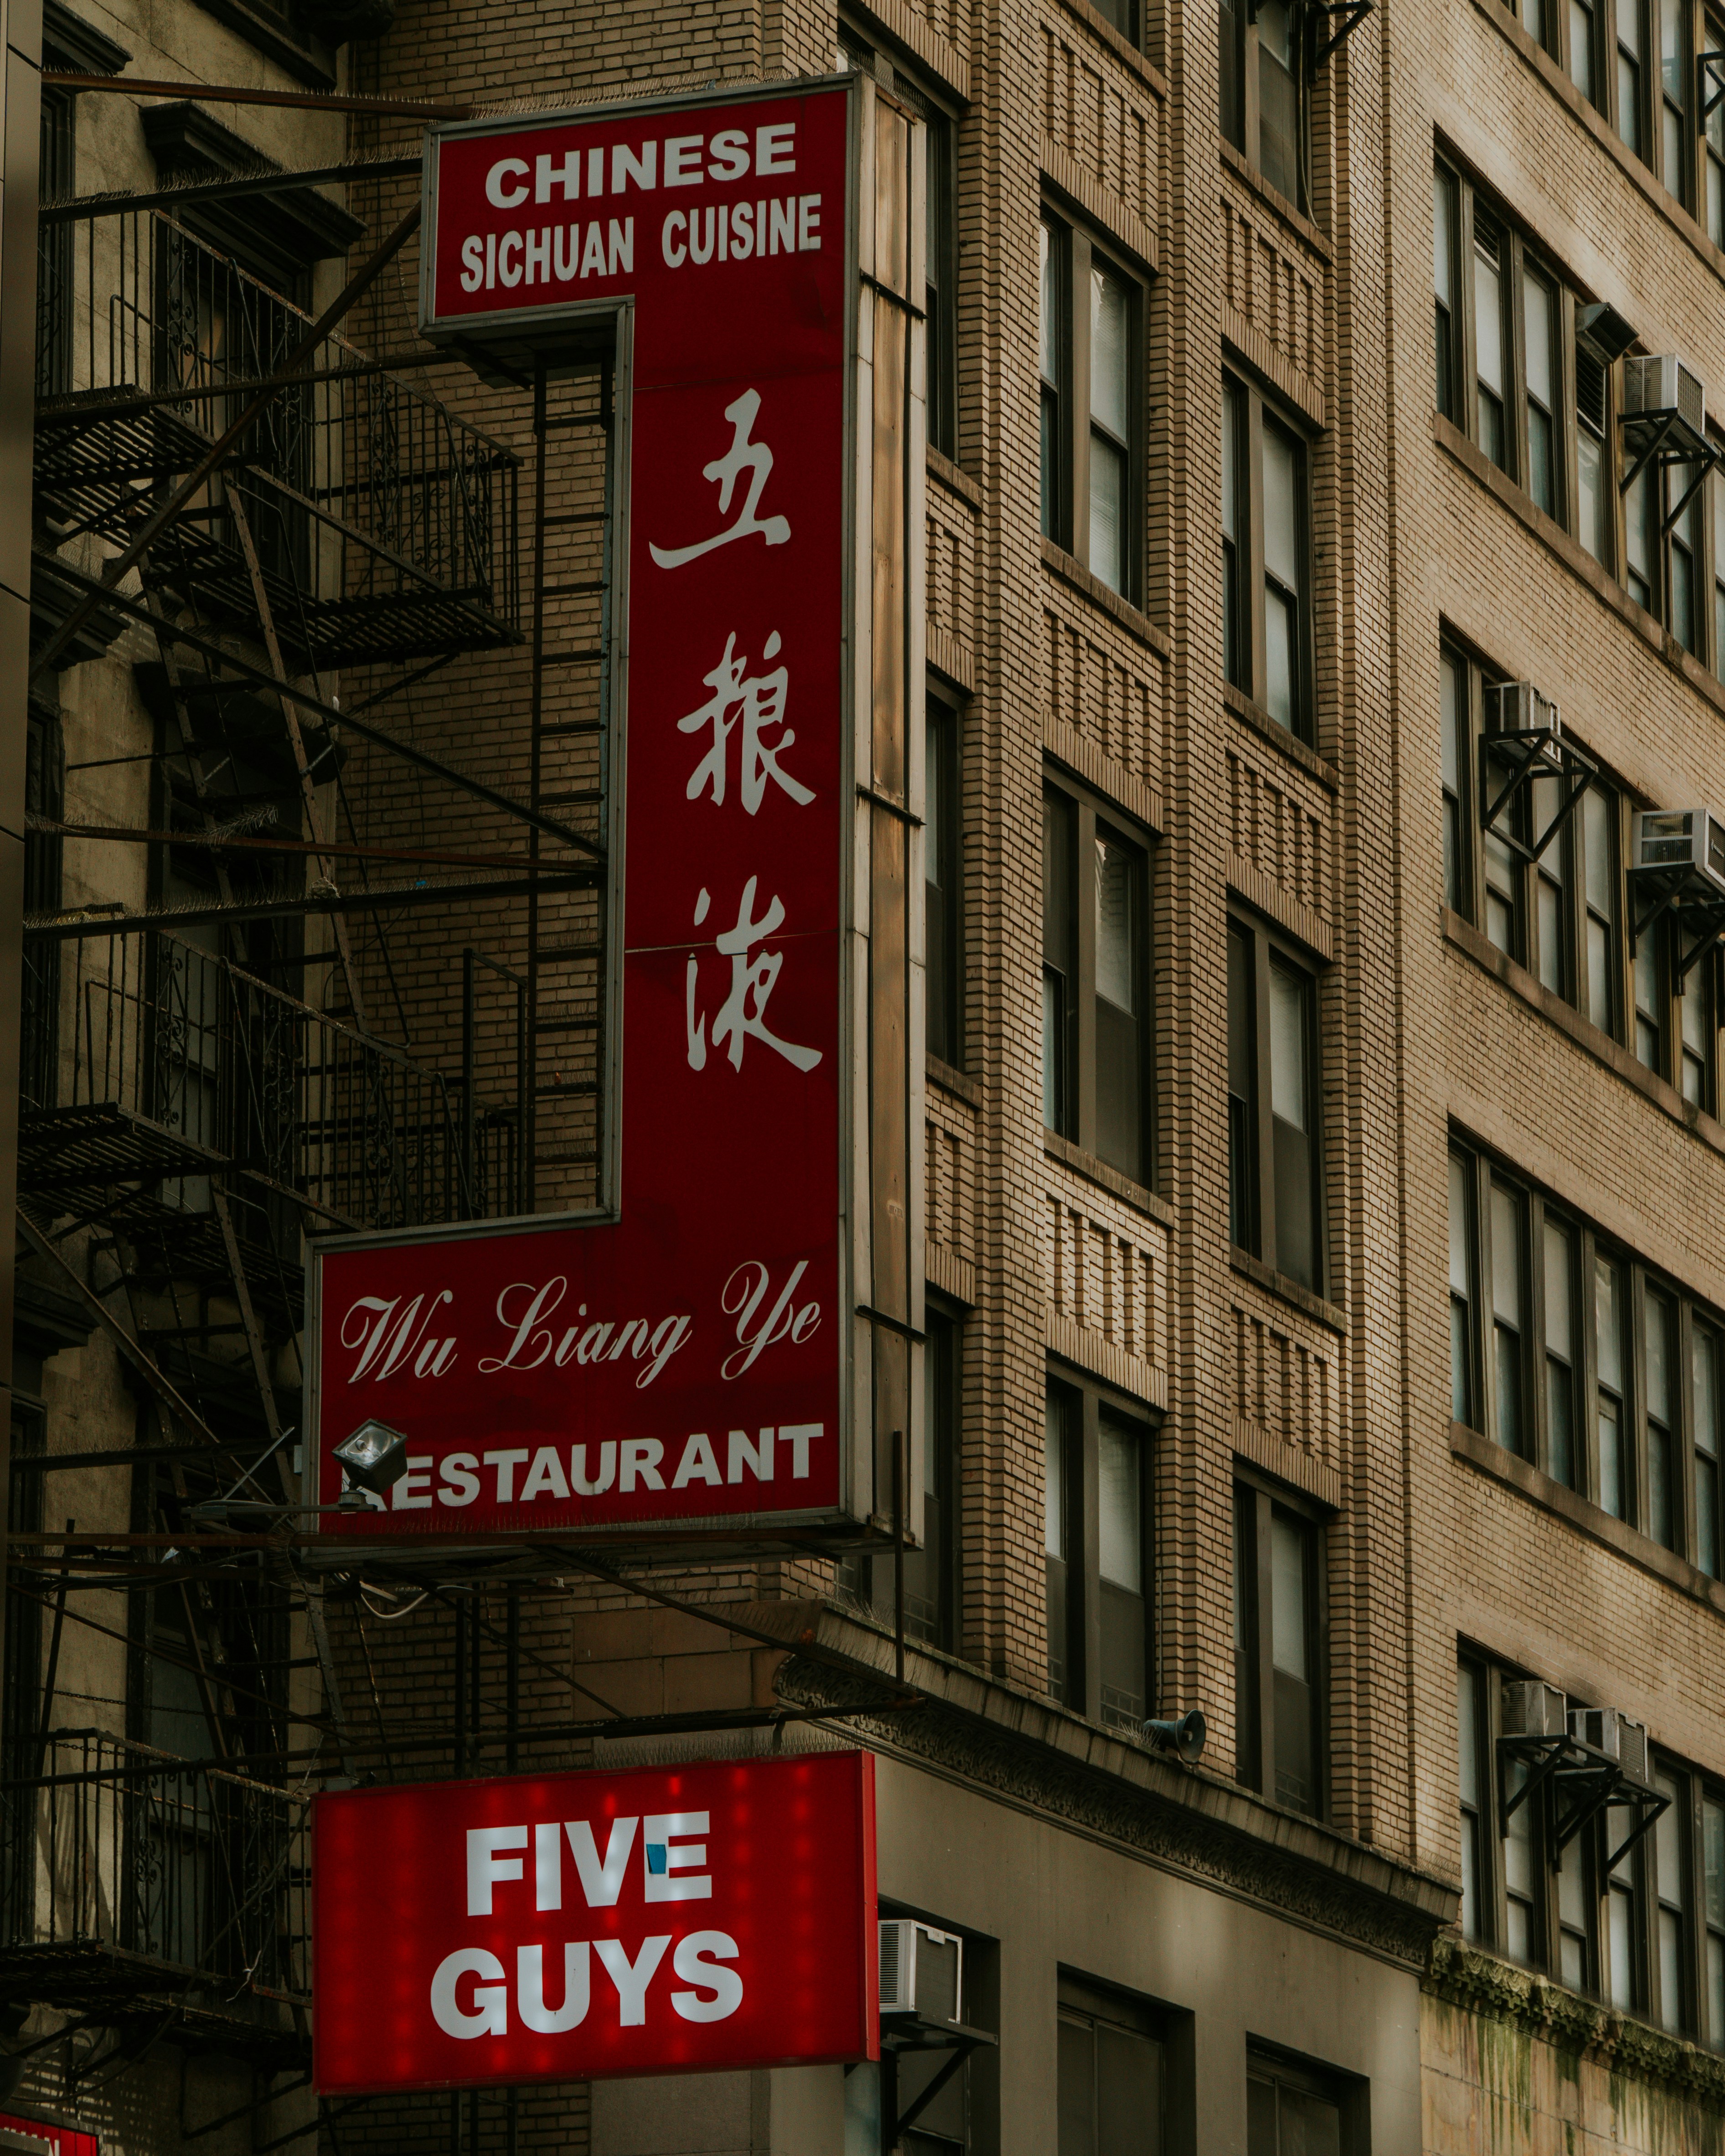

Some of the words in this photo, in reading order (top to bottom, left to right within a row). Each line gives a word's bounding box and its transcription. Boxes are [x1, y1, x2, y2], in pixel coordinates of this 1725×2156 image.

[485, 122, 796, 209] CHINESE
[460, 216, 634, 292] SICHUAN
[661, 193, 821, 268] CUISINE
[341, 1290, 458, 1384] Wu
[478, 1276, 692, 1388] Liang
[721, 1260, 821, 1381] Ye
[466, 1810, 713, 1916] FIVE
[430, 1930, 744, 2040] GUYS
